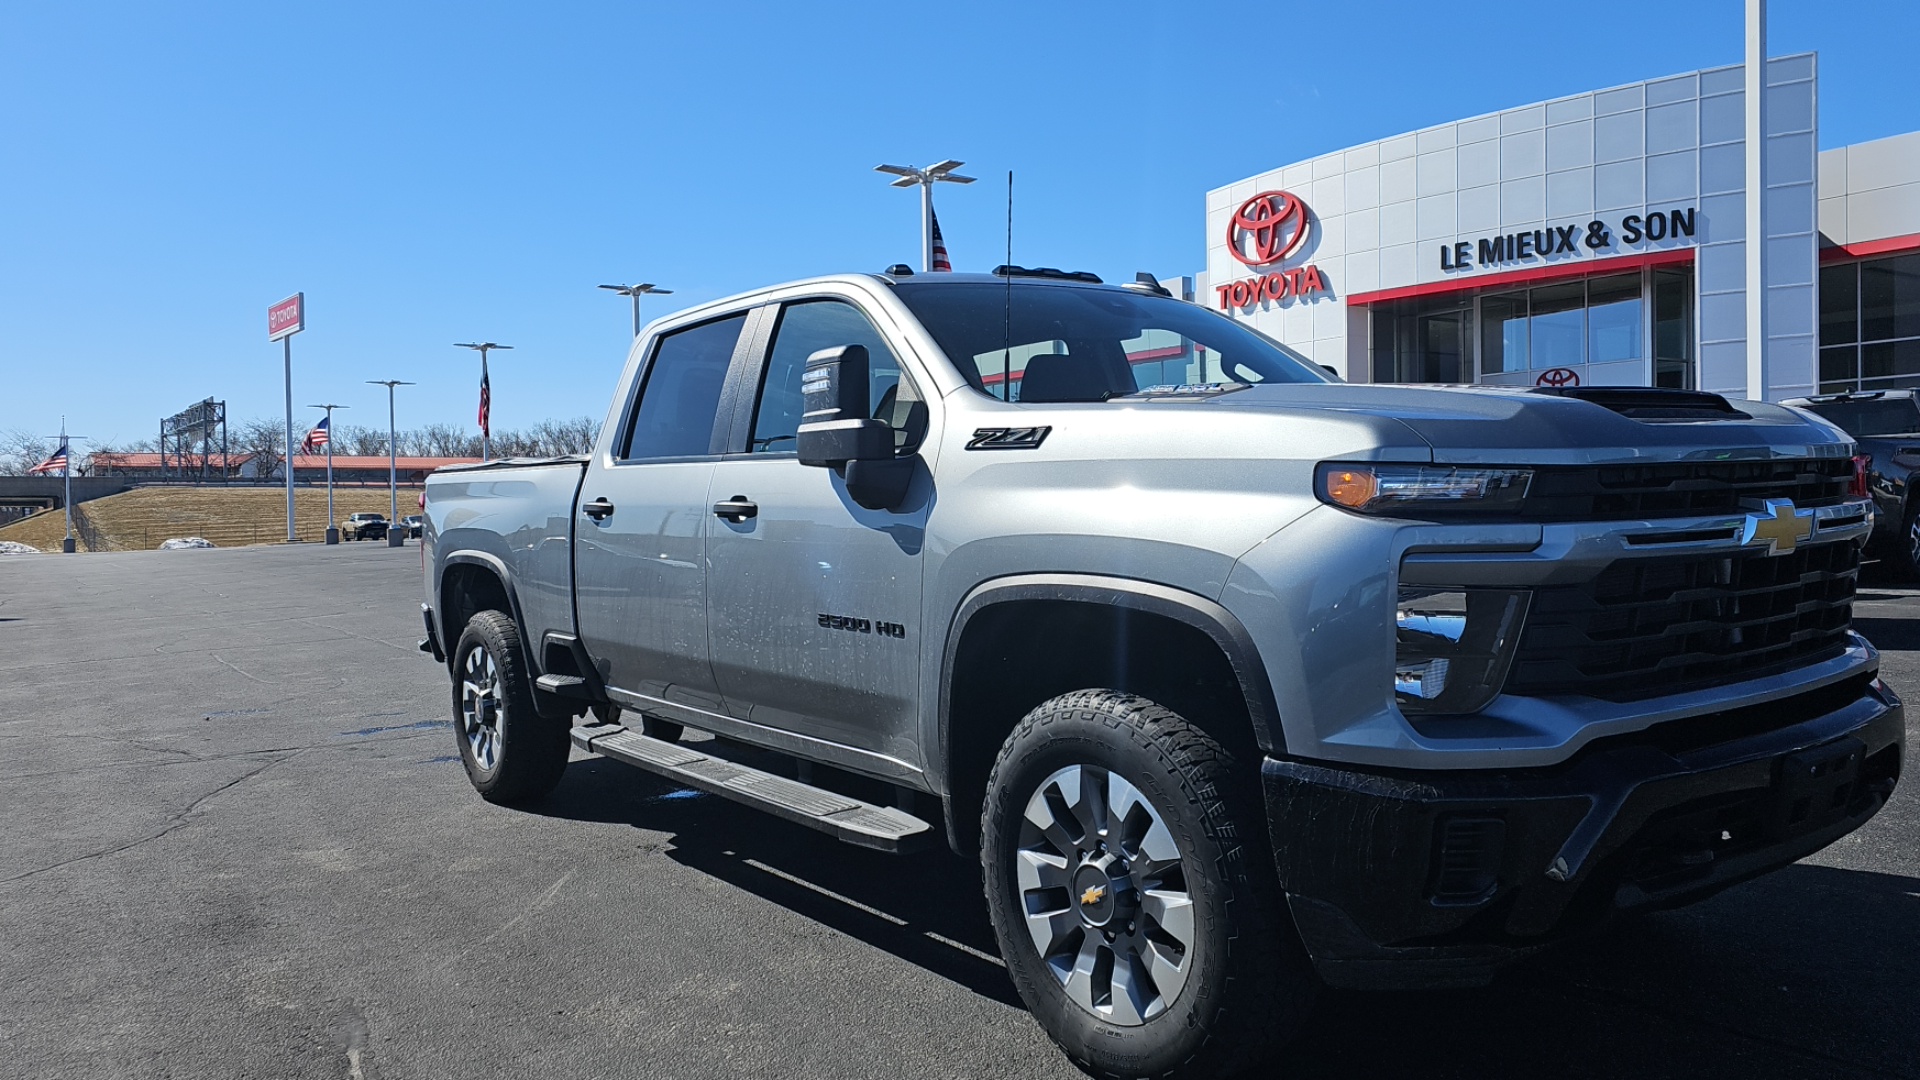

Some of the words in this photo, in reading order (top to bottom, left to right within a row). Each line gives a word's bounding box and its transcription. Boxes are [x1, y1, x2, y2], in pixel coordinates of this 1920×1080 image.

[1441, 242, 1470, 270] LE
[1478, 224, 1576, 265] MIEUX
[1585, 220, 1611, 249] &
[1622, 208, 1695, 244] SON
[1216, 264, 1325, 310] TOYOTA
[276, 305, 297, 323] TOYOTA
[964, 425, 1053, 451] Z71
[817, 613, 872, 634] 2500
[875, 620, 906, 639] HD
